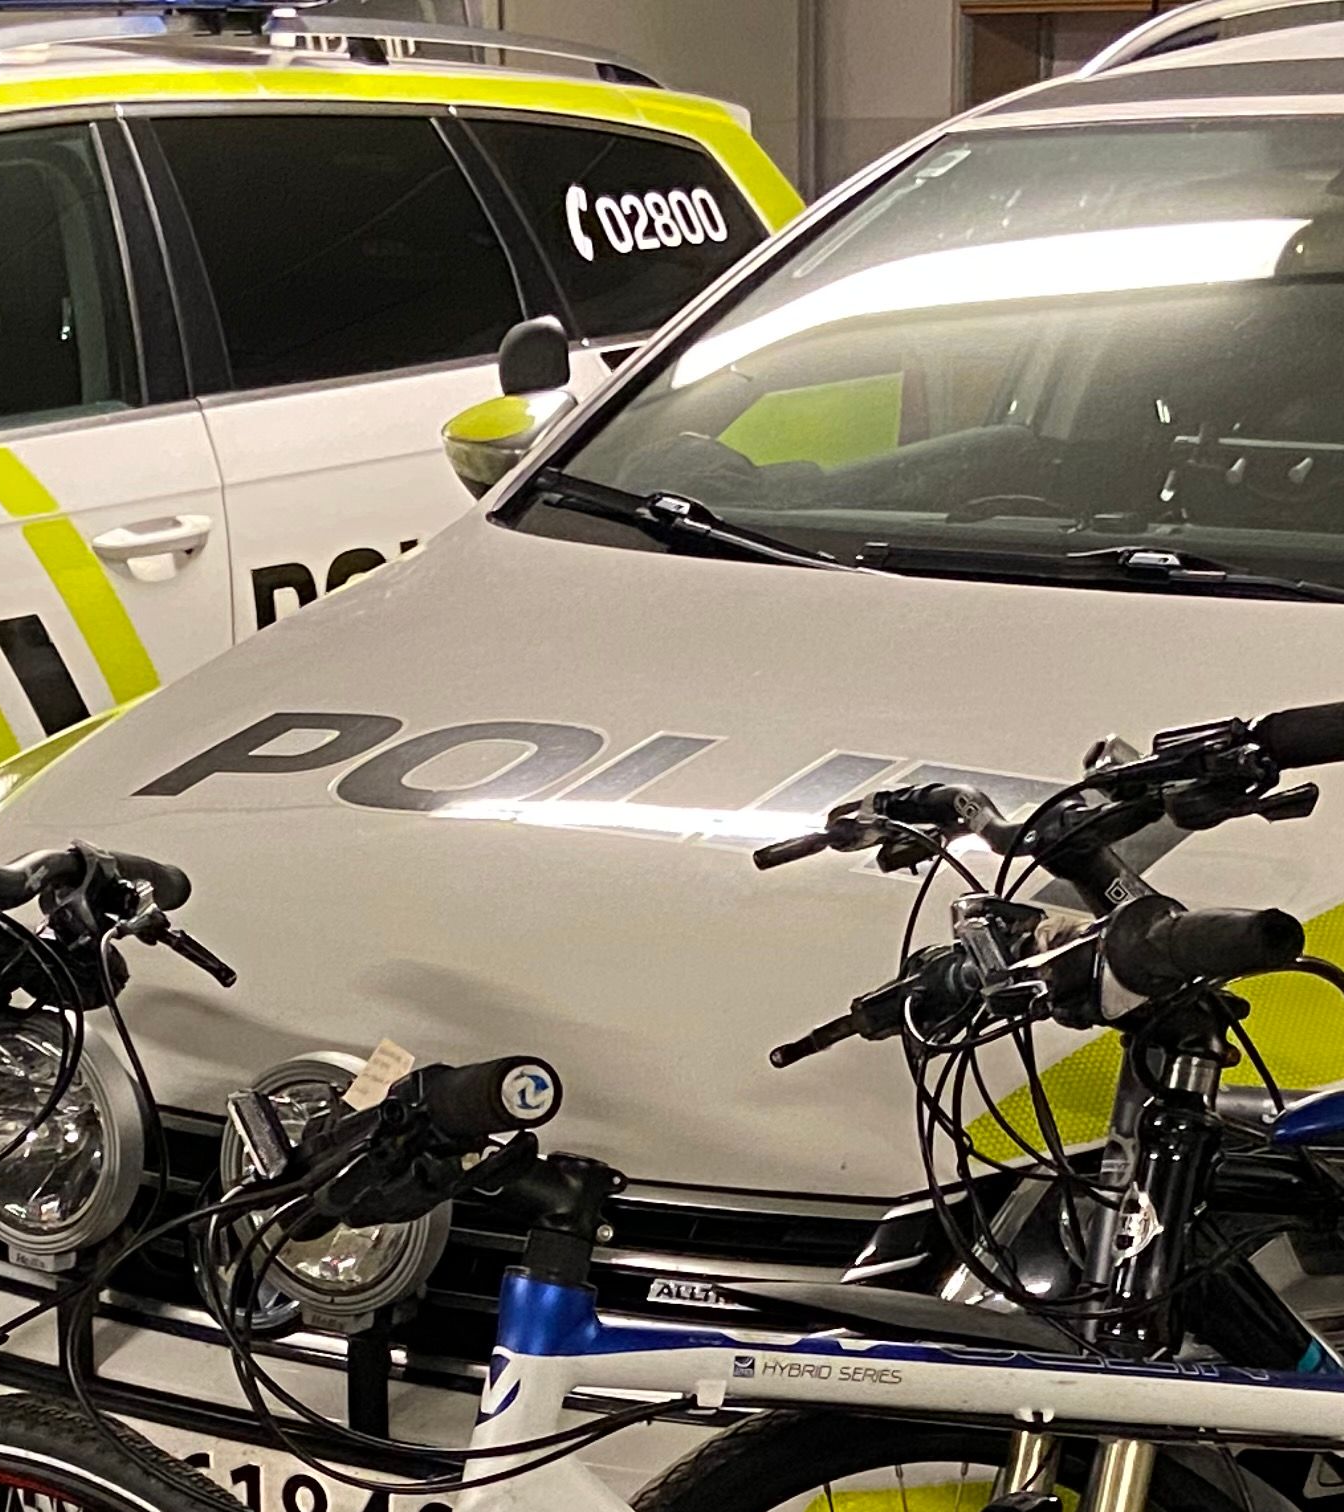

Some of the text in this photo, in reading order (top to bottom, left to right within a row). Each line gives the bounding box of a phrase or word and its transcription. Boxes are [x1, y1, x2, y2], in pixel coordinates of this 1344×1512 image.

[595, 186, 728, 254] 02800
[762, 1361, 833, 1380] HYBRID
[838, 1366, 904, 1385] SERIES
